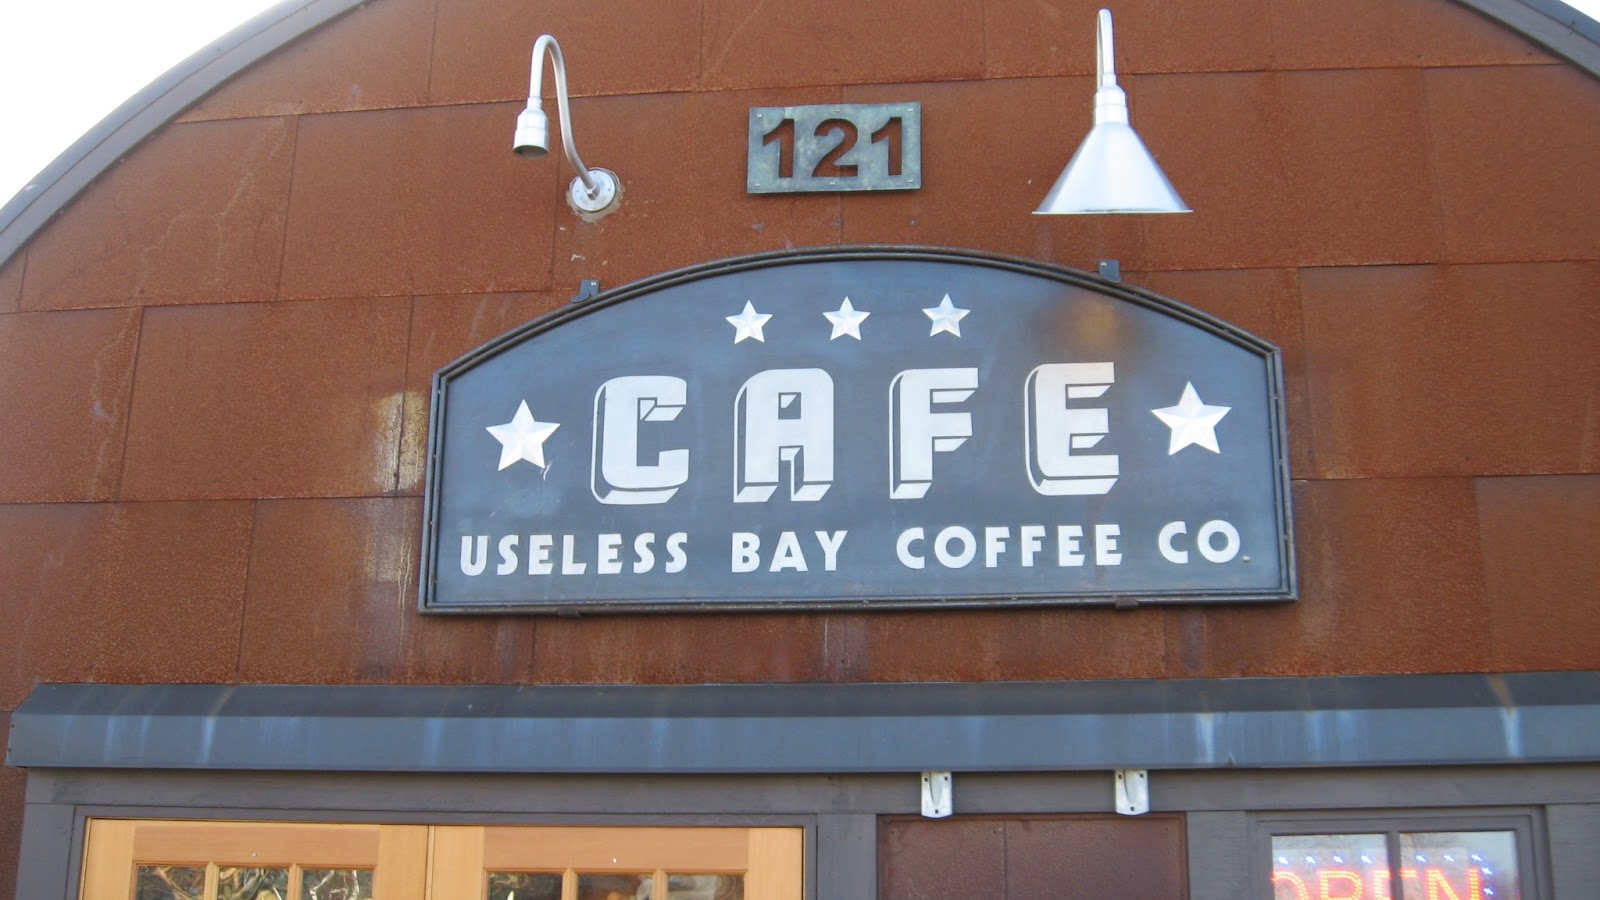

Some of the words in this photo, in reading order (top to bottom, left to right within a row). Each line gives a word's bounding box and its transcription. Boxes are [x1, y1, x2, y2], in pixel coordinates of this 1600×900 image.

[762, 117, 903, 178] 121
[590, 362, 1120, 505] CAFE
[460, 532, 688, 576] USELESS
[731, 530, 848, 573] BAY
[896, 523, 1123, 570] COFFEE
